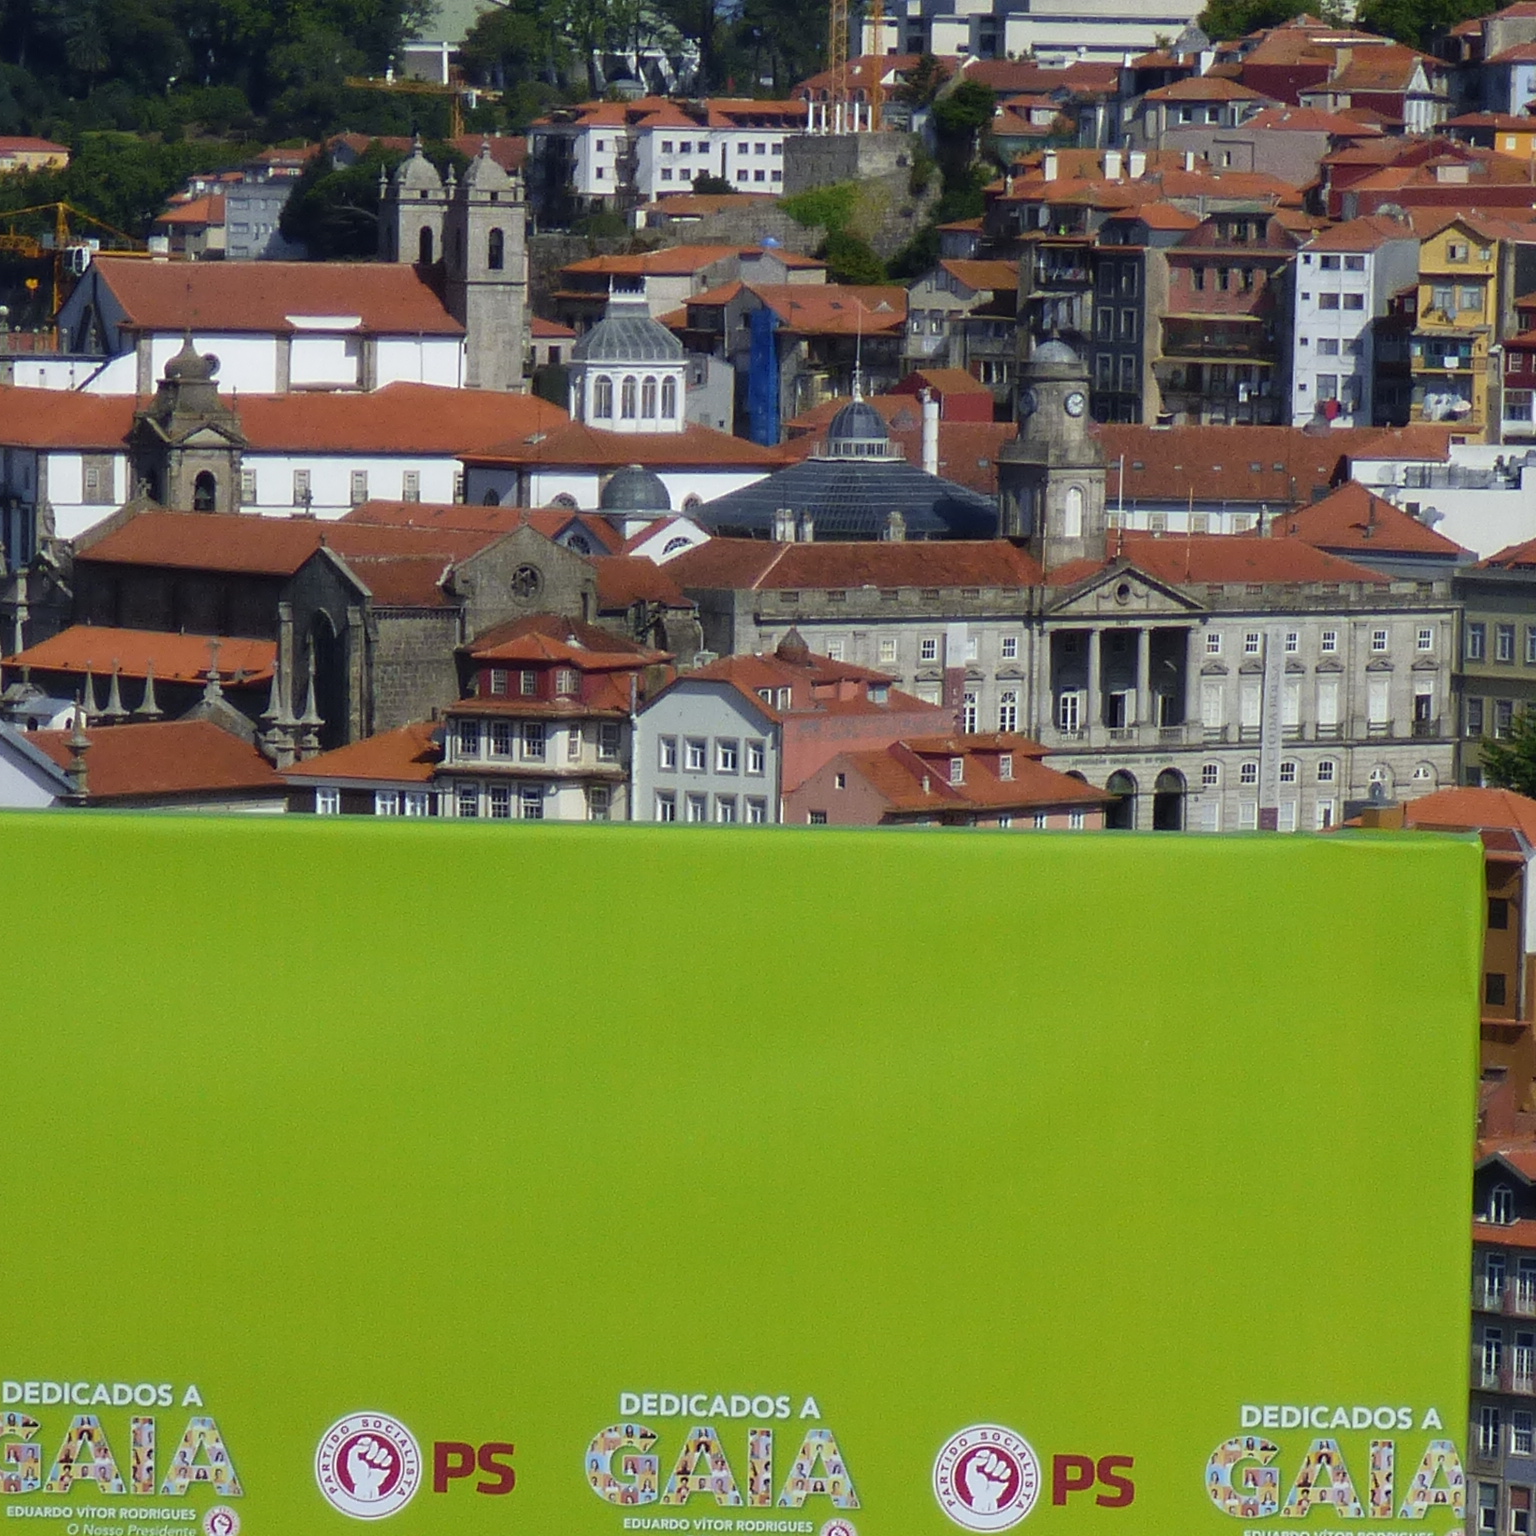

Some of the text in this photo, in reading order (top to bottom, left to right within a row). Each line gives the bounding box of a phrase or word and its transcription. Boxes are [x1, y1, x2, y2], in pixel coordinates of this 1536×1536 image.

[2, 1381, 203, 1407] DEDICADOS A
[620, 1392, 821, 1419] DEDICADOS A
[1241, 1404, 1443, 1430] DEDICADOS A
[322, 1419, 414, 1497] PARTIDO SOCIALISTA
[434, 1442, 516, 1495] PS
[585, 1422, 861, 1509] GAIA
[941, 1432, 1033, 1510] PARTIDO SOCIALISTA
[1205, 1435, 1465, 1519] GAIA
[1053, 1454, 1135, 1508] PS
[7, 1503, 196, 1521] EDUARDO VÍTOR RODRIGUES
[67, 1523, 79, 1536] O
[83, 1523, 123, 1536] Nosso
[623, 1516, 813, 1533] EDUARDO VÍTOR RODRIGUES
